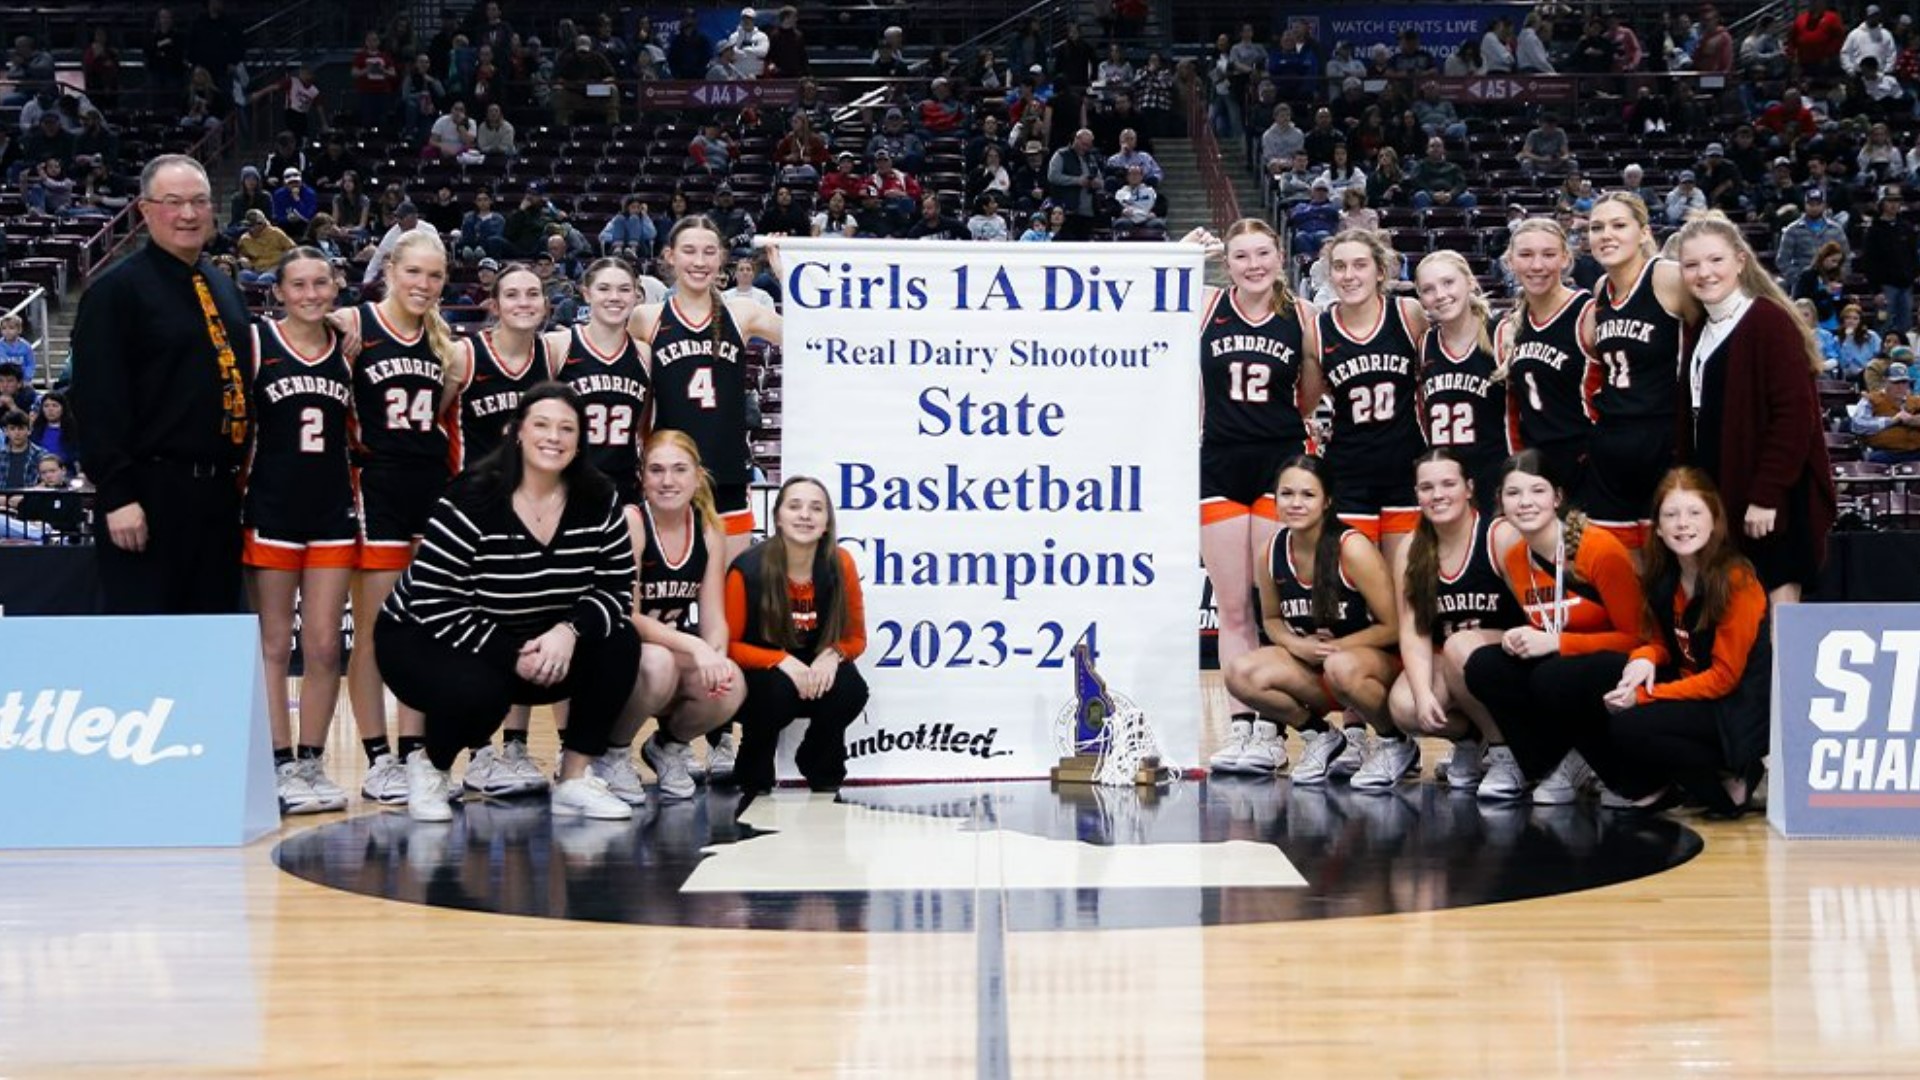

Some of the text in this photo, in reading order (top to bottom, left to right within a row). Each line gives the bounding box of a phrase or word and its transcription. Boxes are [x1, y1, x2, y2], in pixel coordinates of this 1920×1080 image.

[1332, 19, 1478, 33] WATCH EVENTS LIVE
[710, 85, 732, 105] A4
[1486, 79, 1506, 99] A5
[788, 261, 1195, 313] Girls 1A Div II
[655, 339, 740, 367] KENDRCK
[805, 338, 1169, 374] “Real Dairy Shootout”
[1210, 334, 1295, 365] KENDRICK
[1327, 353, 1411, 388] KENDRICK
[1603, 350, 1631, 389] 11
[687, 366, 717, 409] 4
[1228, 361, 1272, 403] 12
[1349, 381, 1396, 425] 20
[1424, 372, 1492, 401] ENDRICK
[1523, 371, 1543, 411] 1
[384, 386, 434, 432] 24
[470, 391, 526, 418] KEND
[584, 403, 633, 445] 32
[917, 386, 1065, 437] State
[1430, 402, 1476, 445] 22
[301, 406, 325, 452] 2
[835, 462, 1143, 512] Basketball
[1436, 592, 1500, 614] NDRICK
[875, 619, 1100, 668] 2023-24
[1808, 629, 1920, 732] ST
[1808, 737, 1920, 791] CHA
